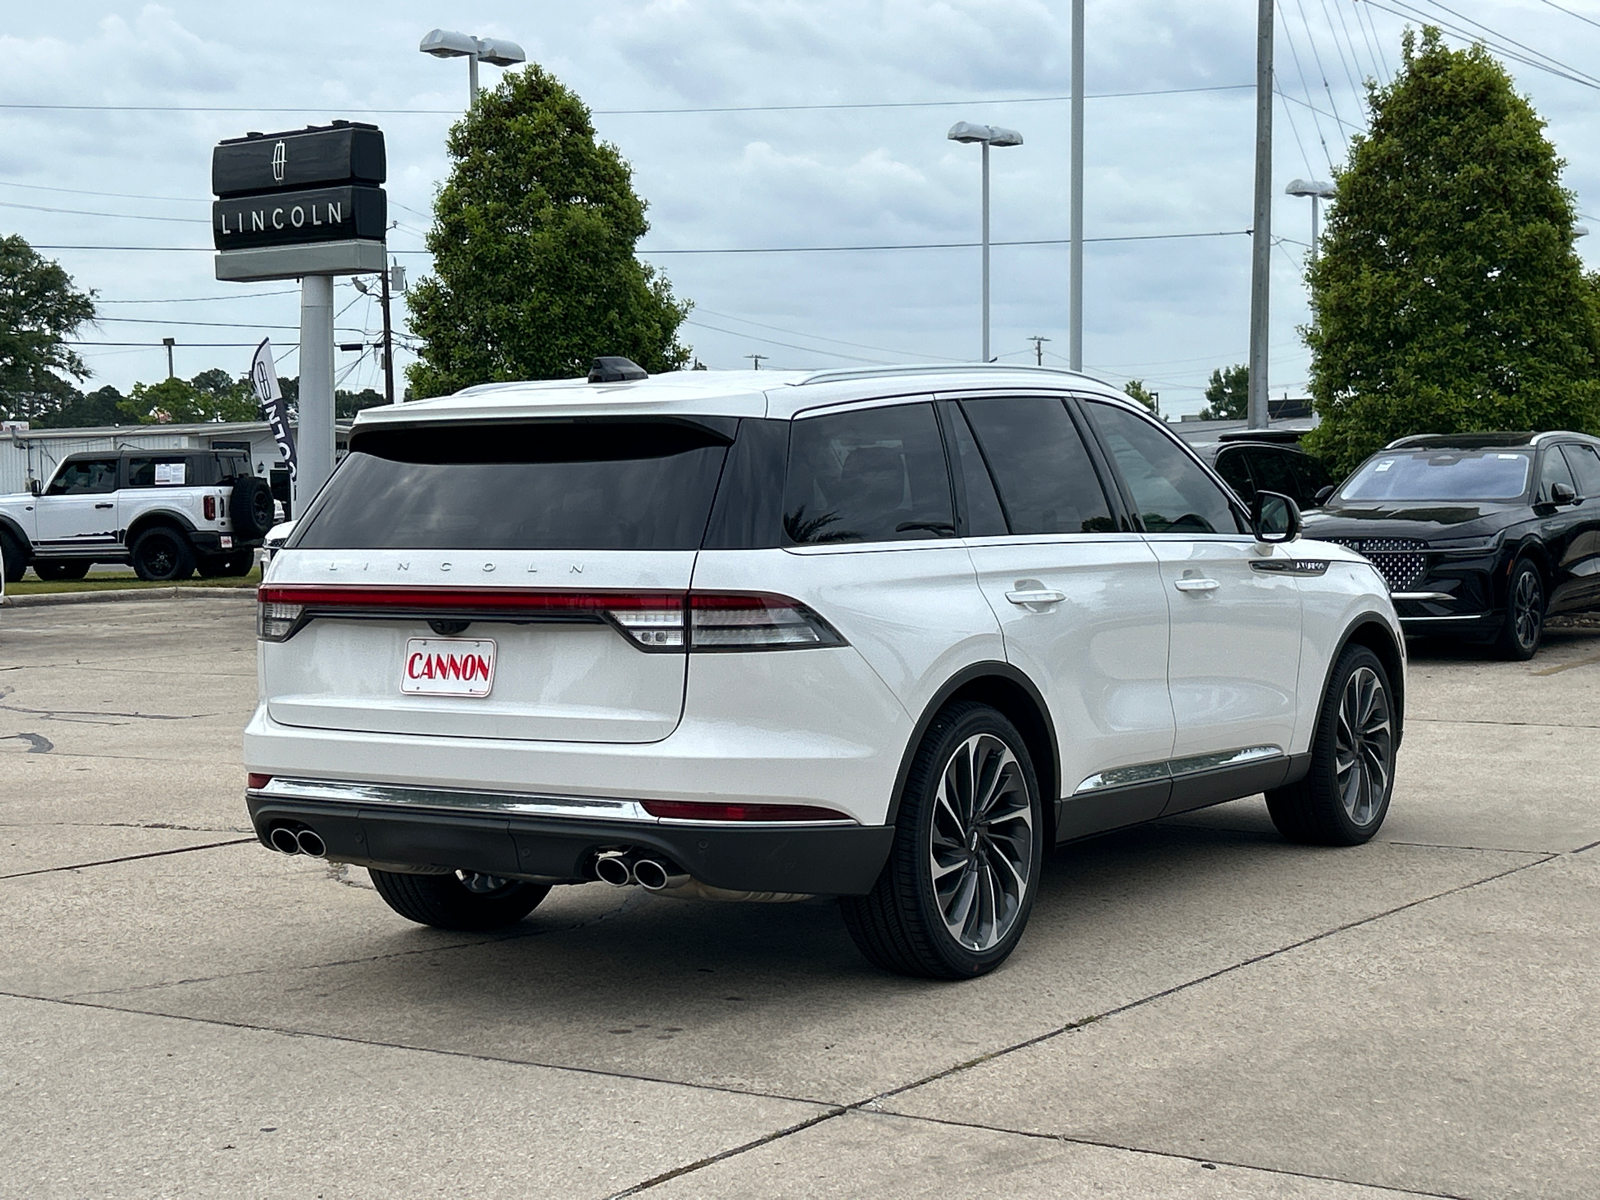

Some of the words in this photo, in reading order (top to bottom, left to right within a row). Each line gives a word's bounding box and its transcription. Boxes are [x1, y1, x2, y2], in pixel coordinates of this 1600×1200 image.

[221, 201, 342, 235] LINCOLN
[328, 561, 584, 574] LINCOLN
[408, 652, 491, 682] CANNON
